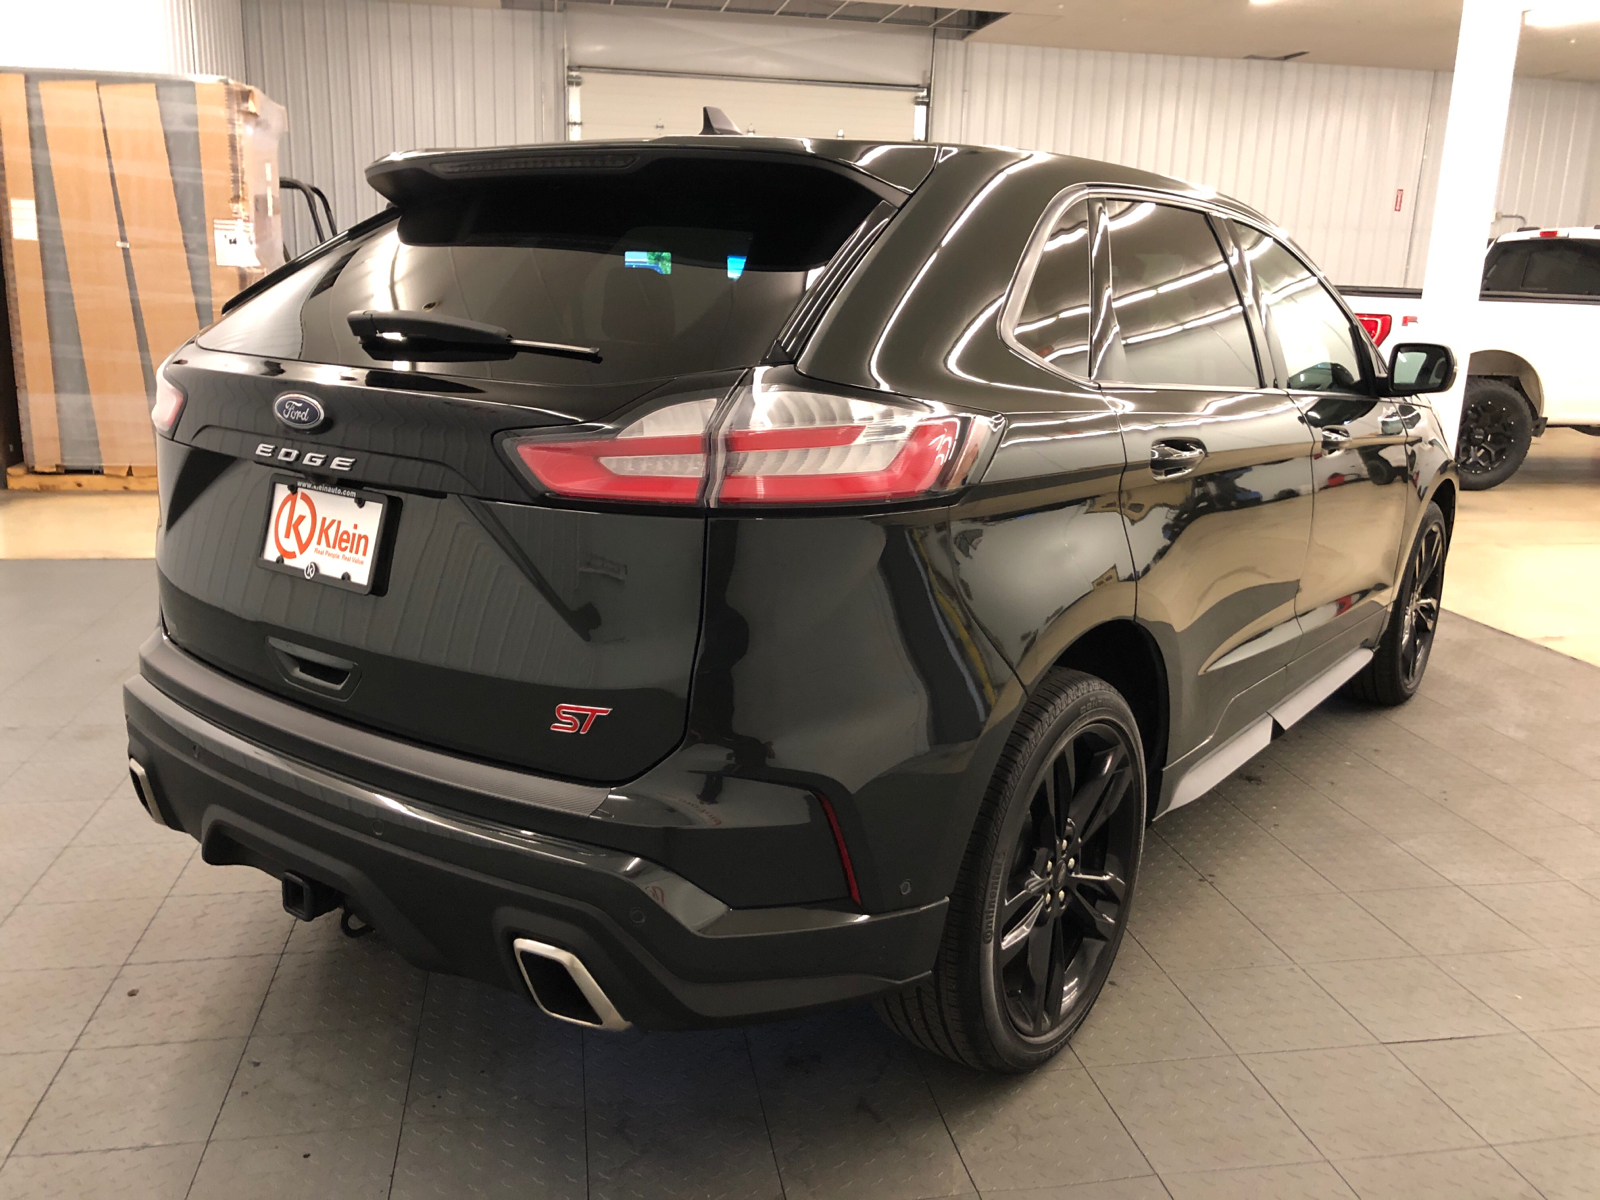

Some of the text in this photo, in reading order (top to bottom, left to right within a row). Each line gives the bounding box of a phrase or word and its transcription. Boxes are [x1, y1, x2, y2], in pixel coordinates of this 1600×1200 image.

[283, 401, 310, 421] Ford
[255, 443, 356, 471] EDGE
[317, 517, 369, 557] Klein
[549, 702, 614, 735] ST
